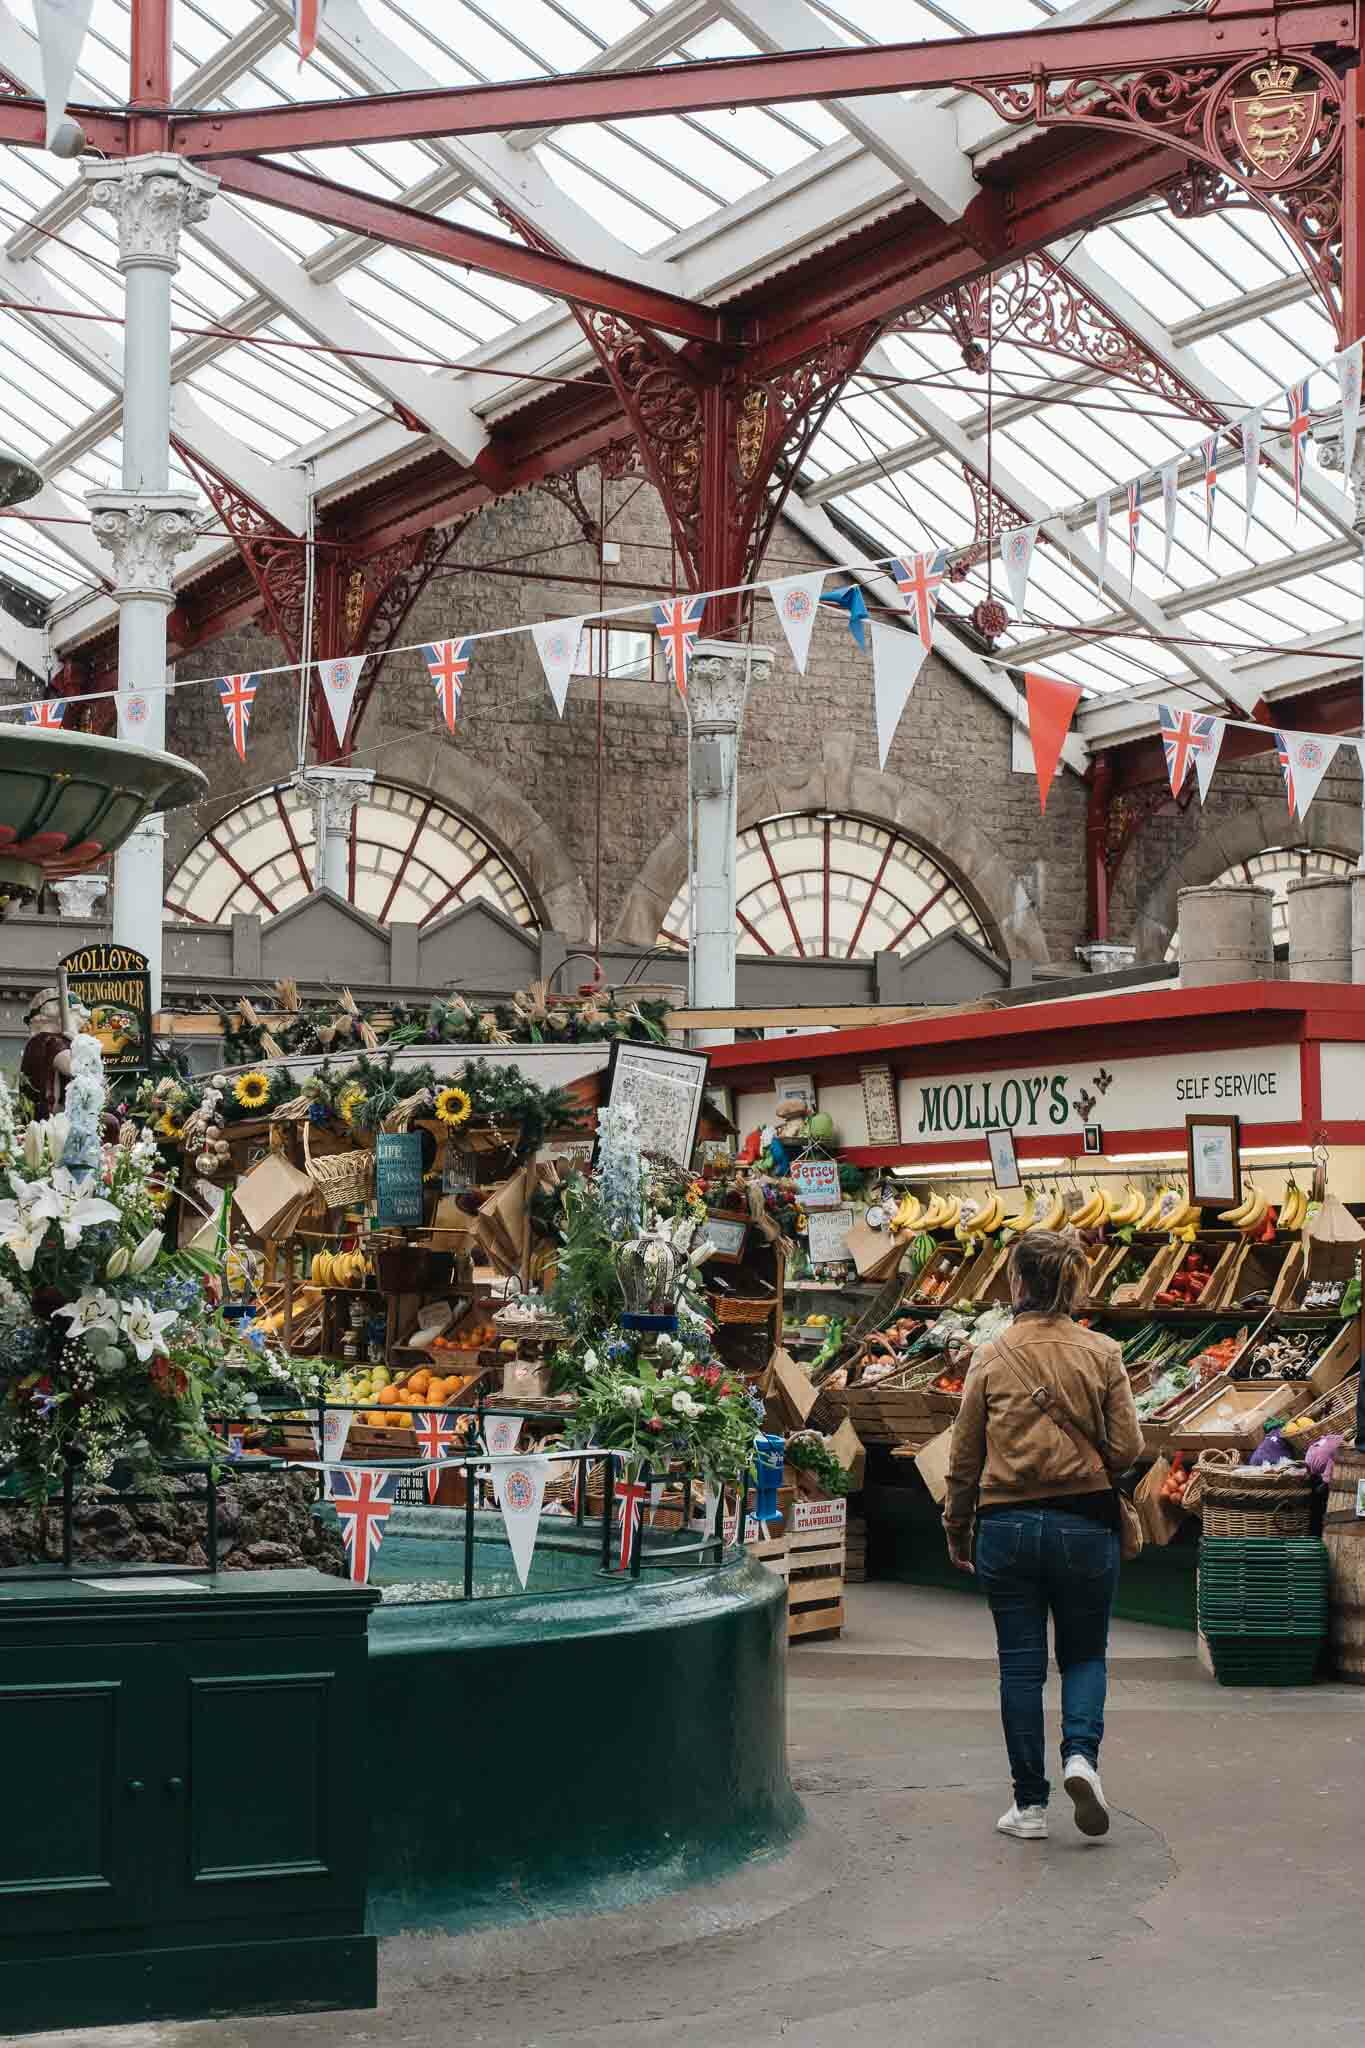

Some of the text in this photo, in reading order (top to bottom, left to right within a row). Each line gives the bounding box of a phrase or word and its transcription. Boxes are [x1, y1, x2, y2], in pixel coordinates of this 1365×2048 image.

[66, 948, 145, 973] MOLLOY'S
[120, 1055, 140, 1063] 2014
[1176, 1072, 1277, 1101] SELF SERVICE
[918, 1075, 1069, 1133] MOLLOY'S
[790, 1162, 835, 1181] Jersey
[809, 1504, 832, 1515] JERSEY
[798, 1515, 843, 1529] STRAWBERRIES
